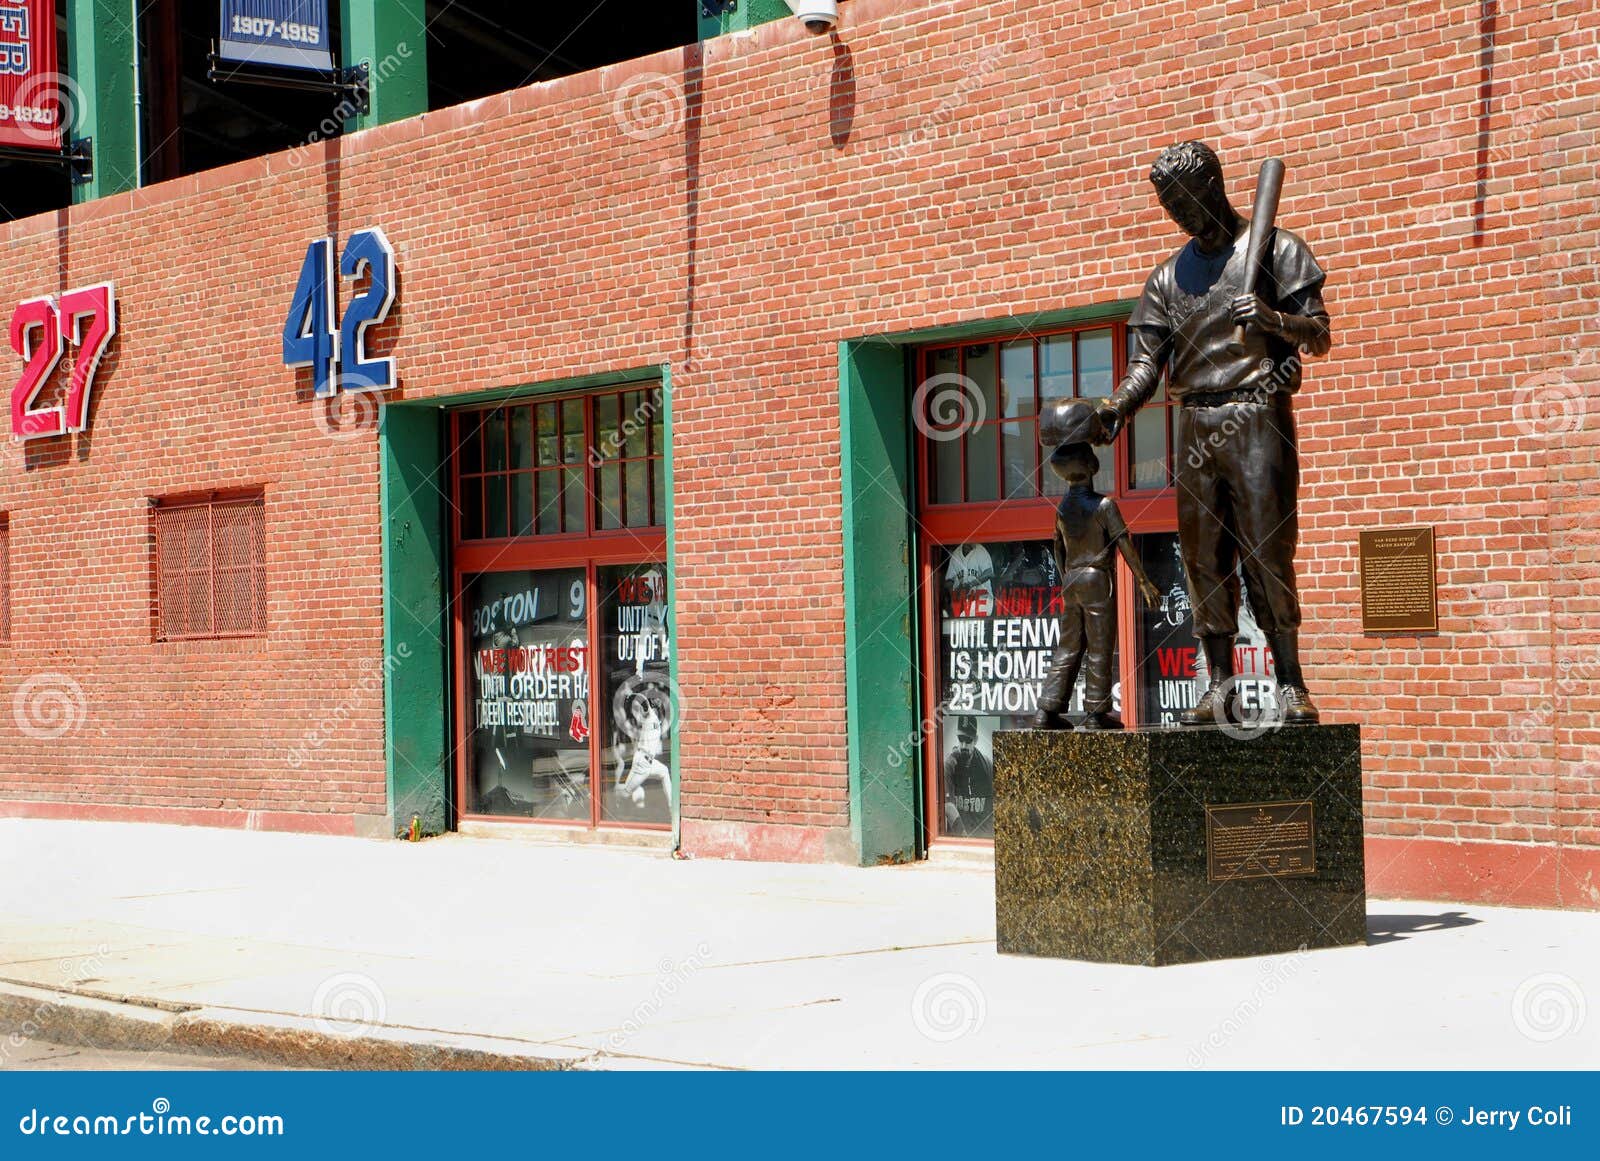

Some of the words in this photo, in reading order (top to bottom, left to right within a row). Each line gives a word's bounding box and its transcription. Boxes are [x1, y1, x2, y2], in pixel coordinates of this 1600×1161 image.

[232, 15, 320, 44] 1907-1915
[283, 227, 397, 398] 42
[11, 281, 116, 440] 27
[570, 579, 585, 618] 9
[618, 576, 650, 603] WE
[951, 589, 988, 617] WE
[995, 587, 1047, 617] WON'T
[618, 634, 640, 660] OUT
[644, 634, 658, 660] OF
[950, 619, 988, 648] UNTIL
[480, 648, 506, 673] WE
[545, 647, 588, 673] REST
[950, 650, 971, 680] IS
[977, 650, 1052, 679] HOME
[1157, 647, 1197, 677] WE
[510, 674, 571, 699] ORDER
[950, 682, 974, 711] 25
[1159, 679, 1197, 709] UNTIL
[482, 701, 505, 726] BEEN
[507, 701, 559, 726] RESTORED.
